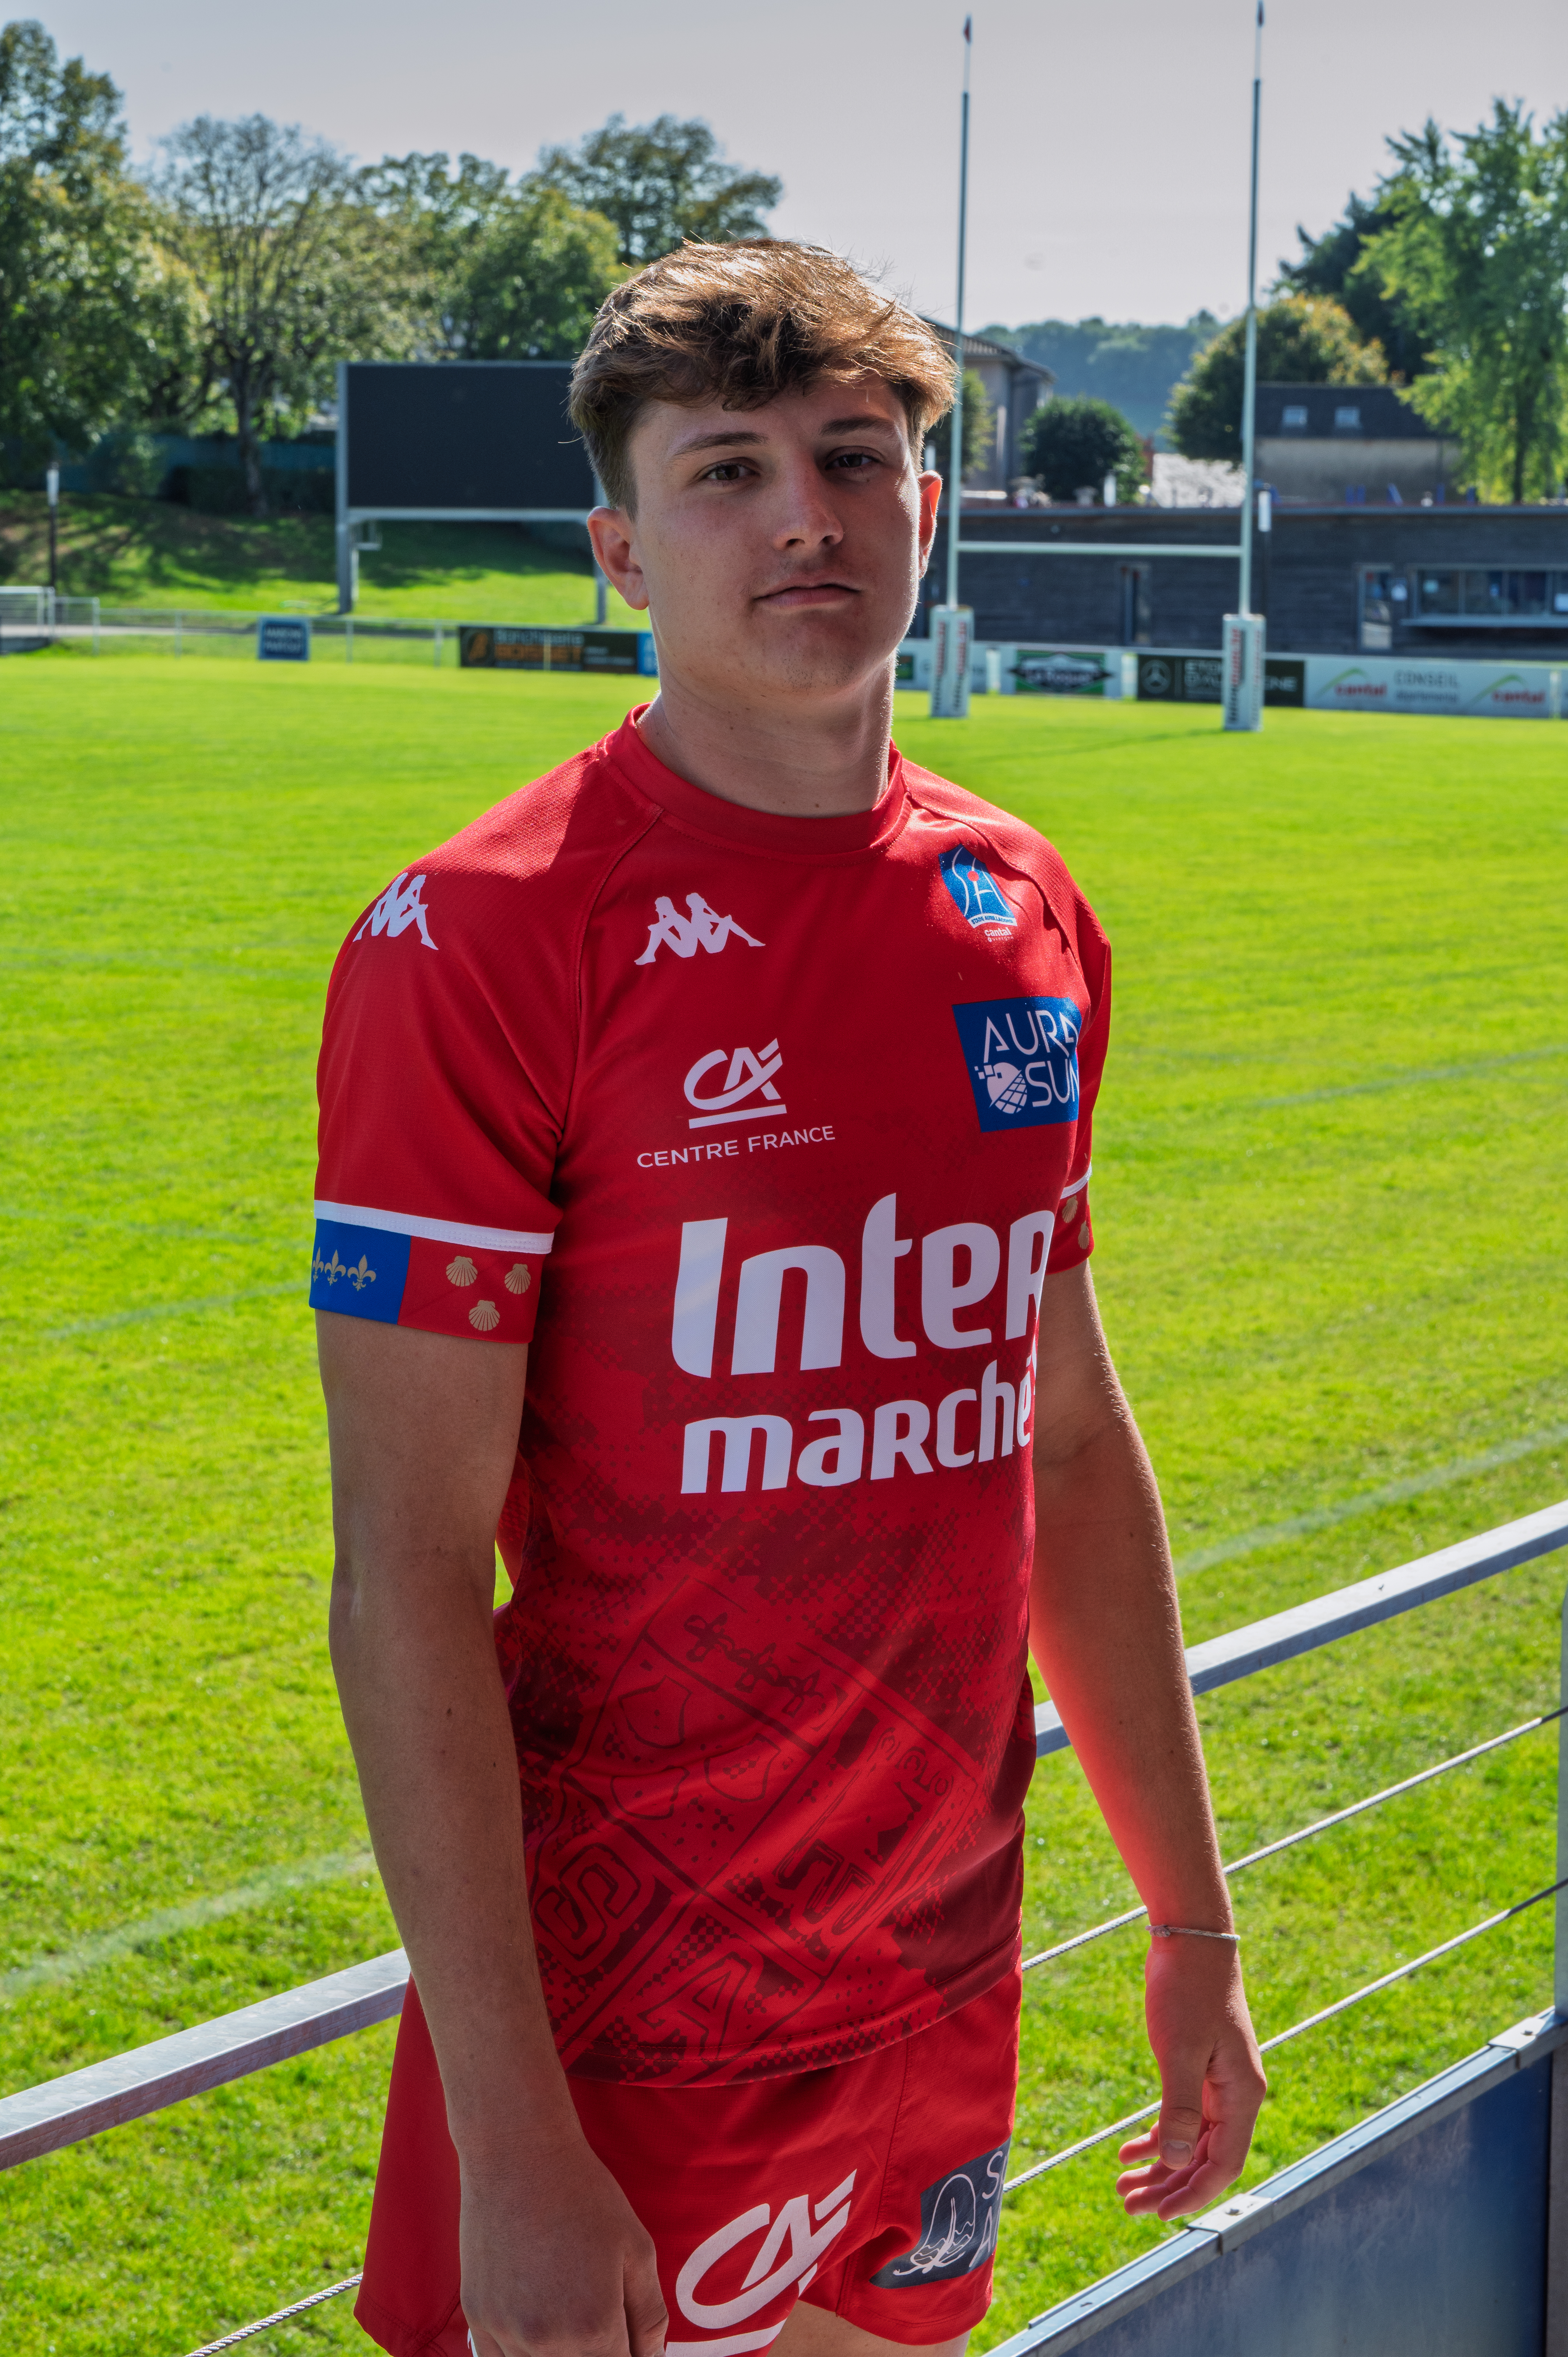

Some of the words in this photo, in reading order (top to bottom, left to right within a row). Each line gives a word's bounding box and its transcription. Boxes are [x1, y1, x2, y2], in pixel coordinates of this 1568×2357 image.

[1394, 670, 1458, 687] CONSEIL
[1335, 682, 1387, 696] cantal
[1492, 689, 1545, 703] cantal
[984, 927, 1012, 936] cantal
[984, 1010, 1079, 1063] AURA
[637, 1140, 739, 1168] CENTRE
[748, 1125, 835, 1152] FRANCE
